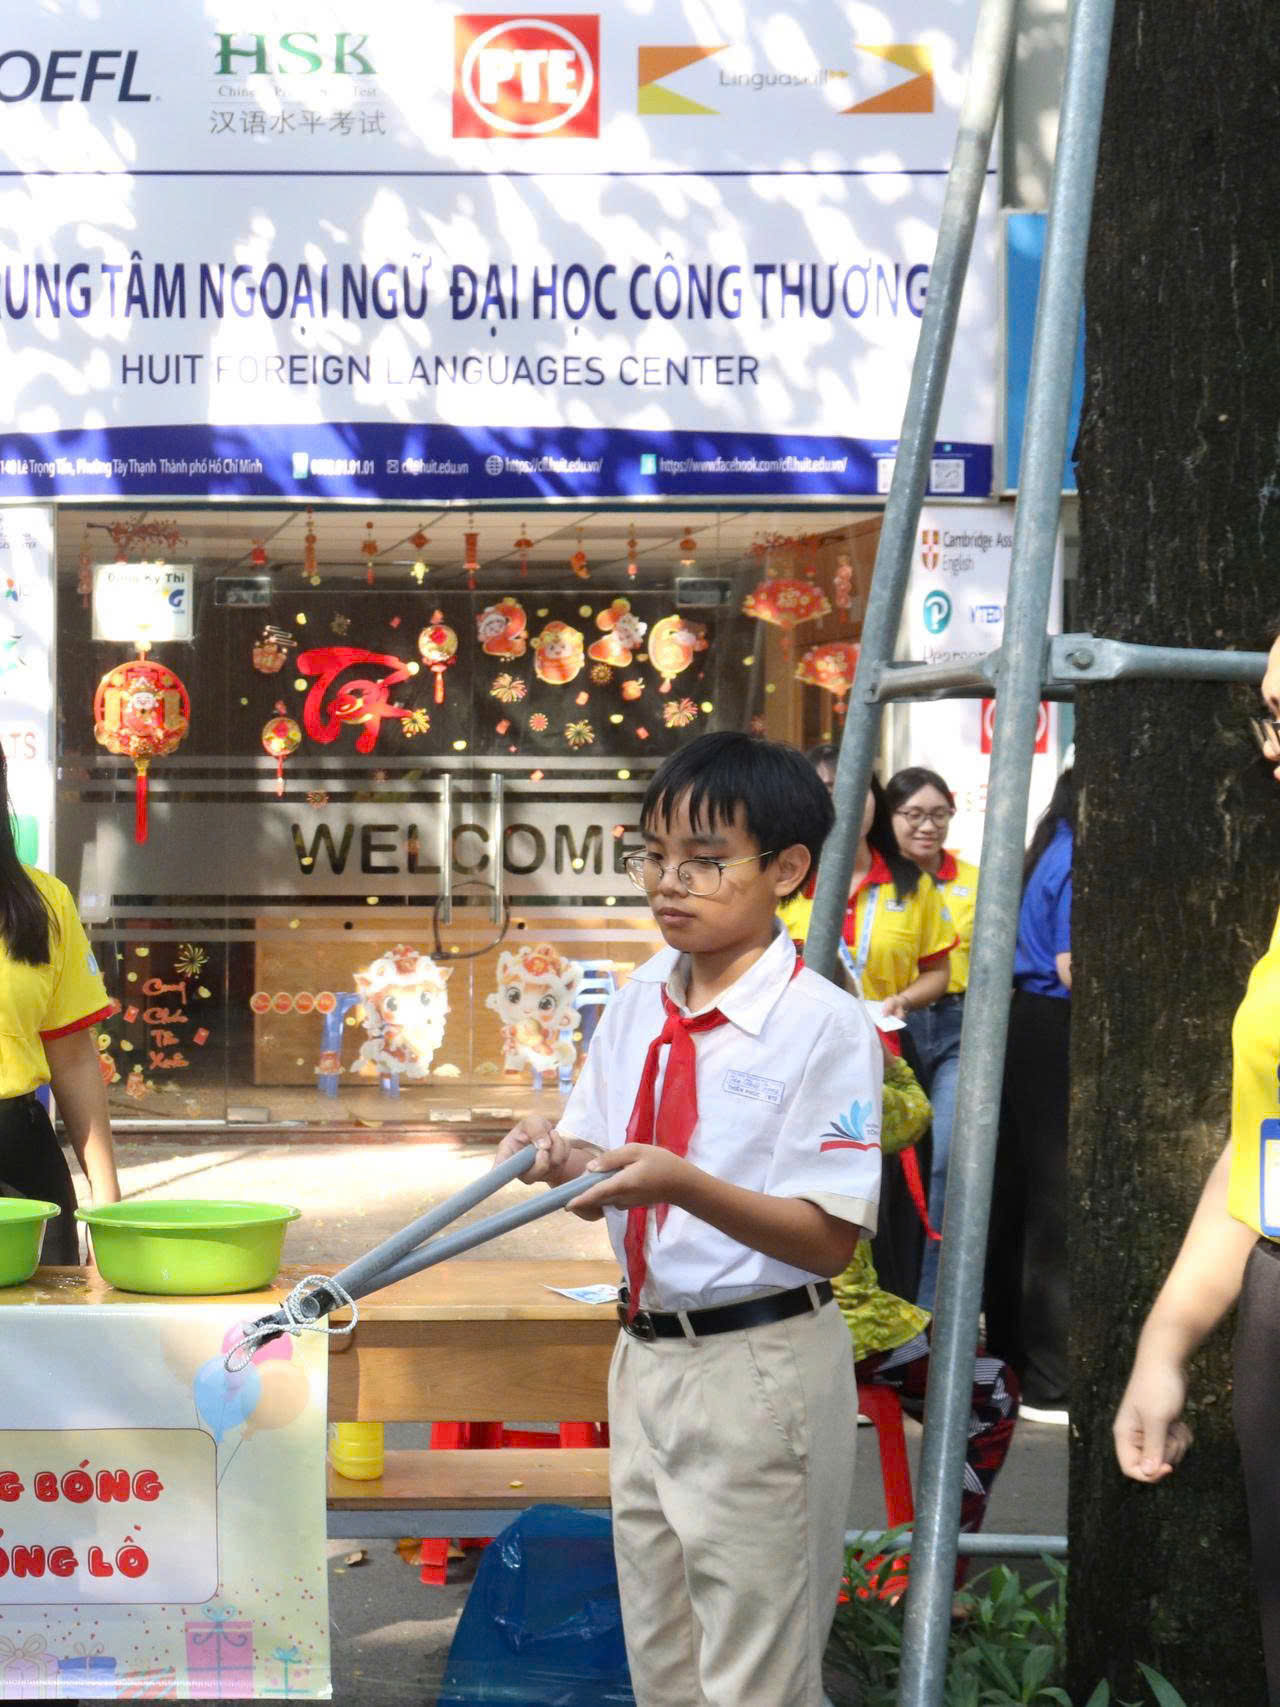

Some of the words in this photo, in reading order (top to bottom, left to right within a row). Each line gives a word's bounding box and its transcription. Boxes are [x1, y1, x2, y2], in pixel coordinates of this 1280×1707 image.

[214, 31, 378, 76] HSK
[479, 48, 579, 104] PTE
[210, 109, 387, 136] 汉语水平考试
[102, 250, 187, 320] TÂM
[200, 262, 328, 336] NGOẠI
[343, 252, 433, 321] NGỮ
[449, 262, 519, 338] ĐẠI
[532, 262, 617, 336] HỌC
[629, 251, 743, 320] CÔNG
[754, 256, 929, 320] THƯƠNG
[121, 354, 204, 386] HUIT
[217, 354, 371, 386] FOREIGN
[387, 354, 606, 386] LANGUAGES
[618, 355, 760, 386] CENTER
[30, 459, 55, 478] Trọng
[112, 458, 127, 477] Tây
[128, 458, 157, 477] Thạnh
[160, 458, 188, 474] Thành
[189, 457, 208, 477] phố
[223, 457, 238, 474] Chí
[239, 457, 263, 474] Minh
[943, 531, 993, 552] Cambridge
[996, 531, 1012, 548] Ass
[166, 573, 185, 583] Thi
[6, 731, 38, 761] TS
[291, 822, 645, 876] WELCOME
[33, 1458, 165, 1505] BÓNG
[87, 1524, 150, 1580] LỒ
